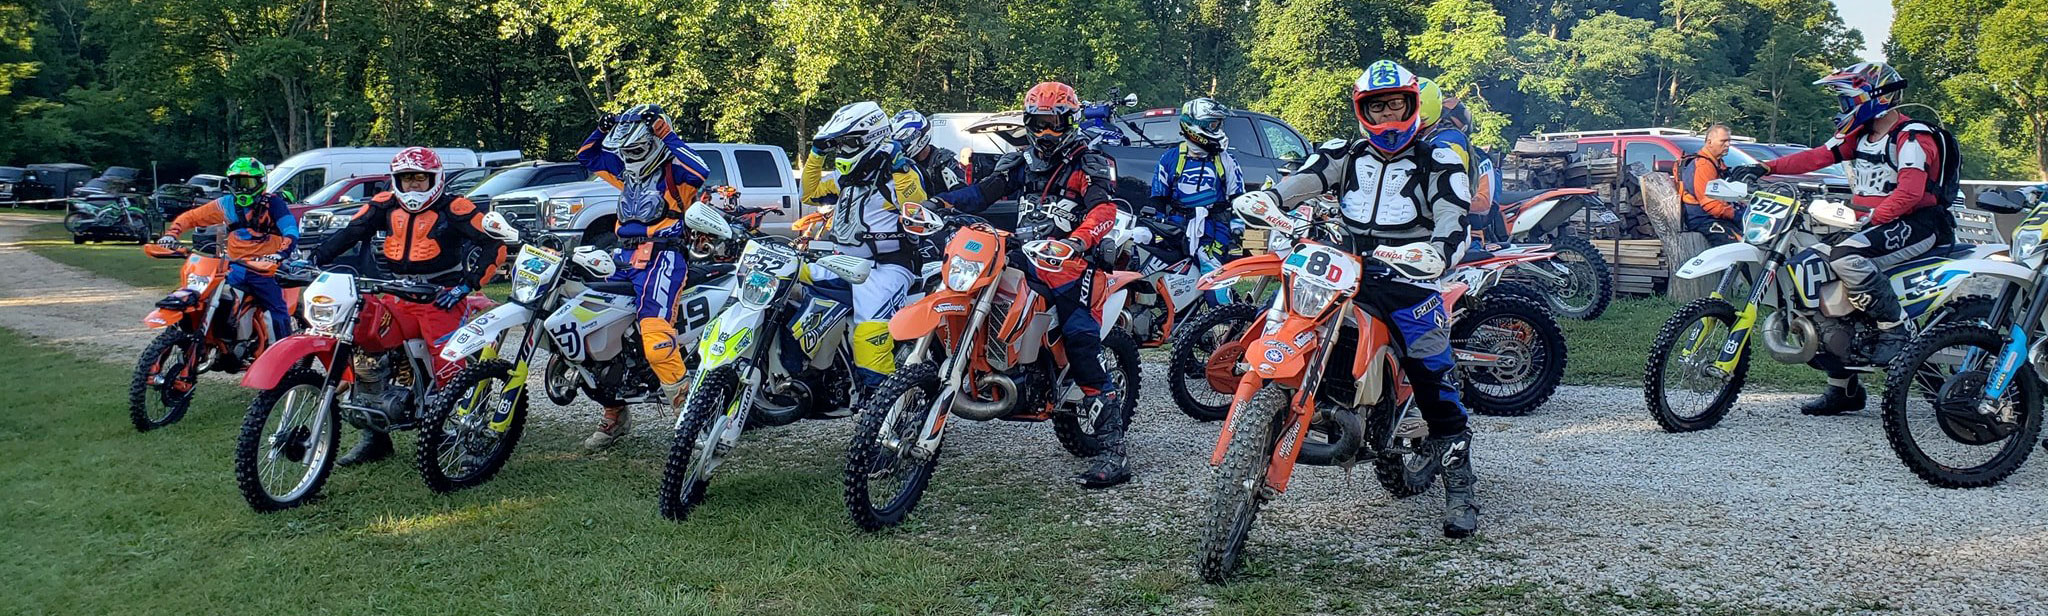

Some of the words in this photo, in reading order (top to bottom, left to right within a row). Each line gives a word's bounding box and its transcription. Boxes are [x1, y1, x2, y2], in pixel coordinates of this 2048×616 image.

[1752, 199, 1789, 214] 517
[1266, 215, 1293, 231] KENDA
[1374, 249, 1403, 262] KENDA
[753, 256, 785, 276] 52
[674, 296, 711, 335] 49
[1413, 297, 1439, 318] FOUR
[738, 385, 753, 428] DUNLOP
